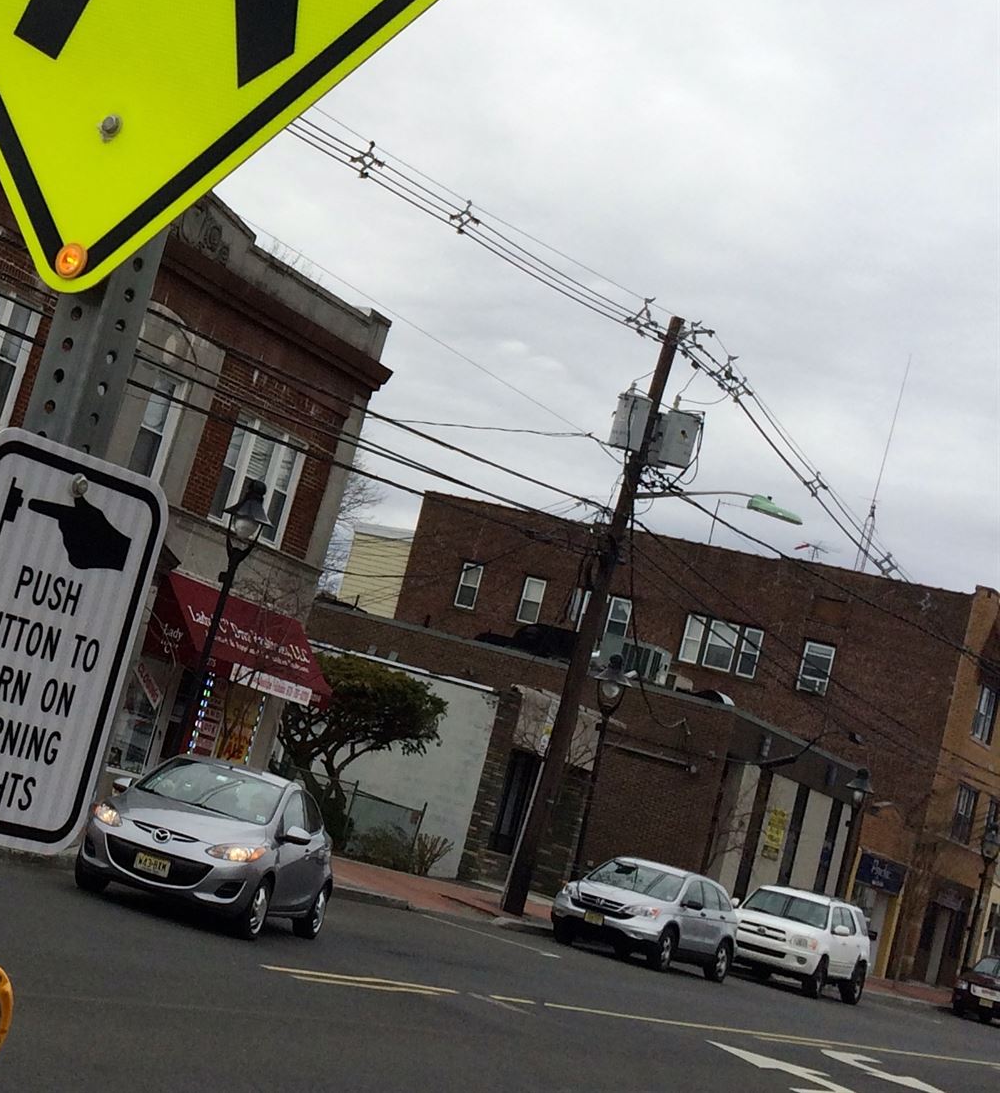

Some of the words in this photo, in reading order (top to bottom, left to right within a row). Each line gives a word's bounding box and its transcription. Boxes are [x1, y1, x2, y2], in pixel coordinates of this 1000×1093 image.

[14, 564, 83, 616] PUSH
[70, 634, 101, 673] TO
[40, 678, 77, 718] ON
